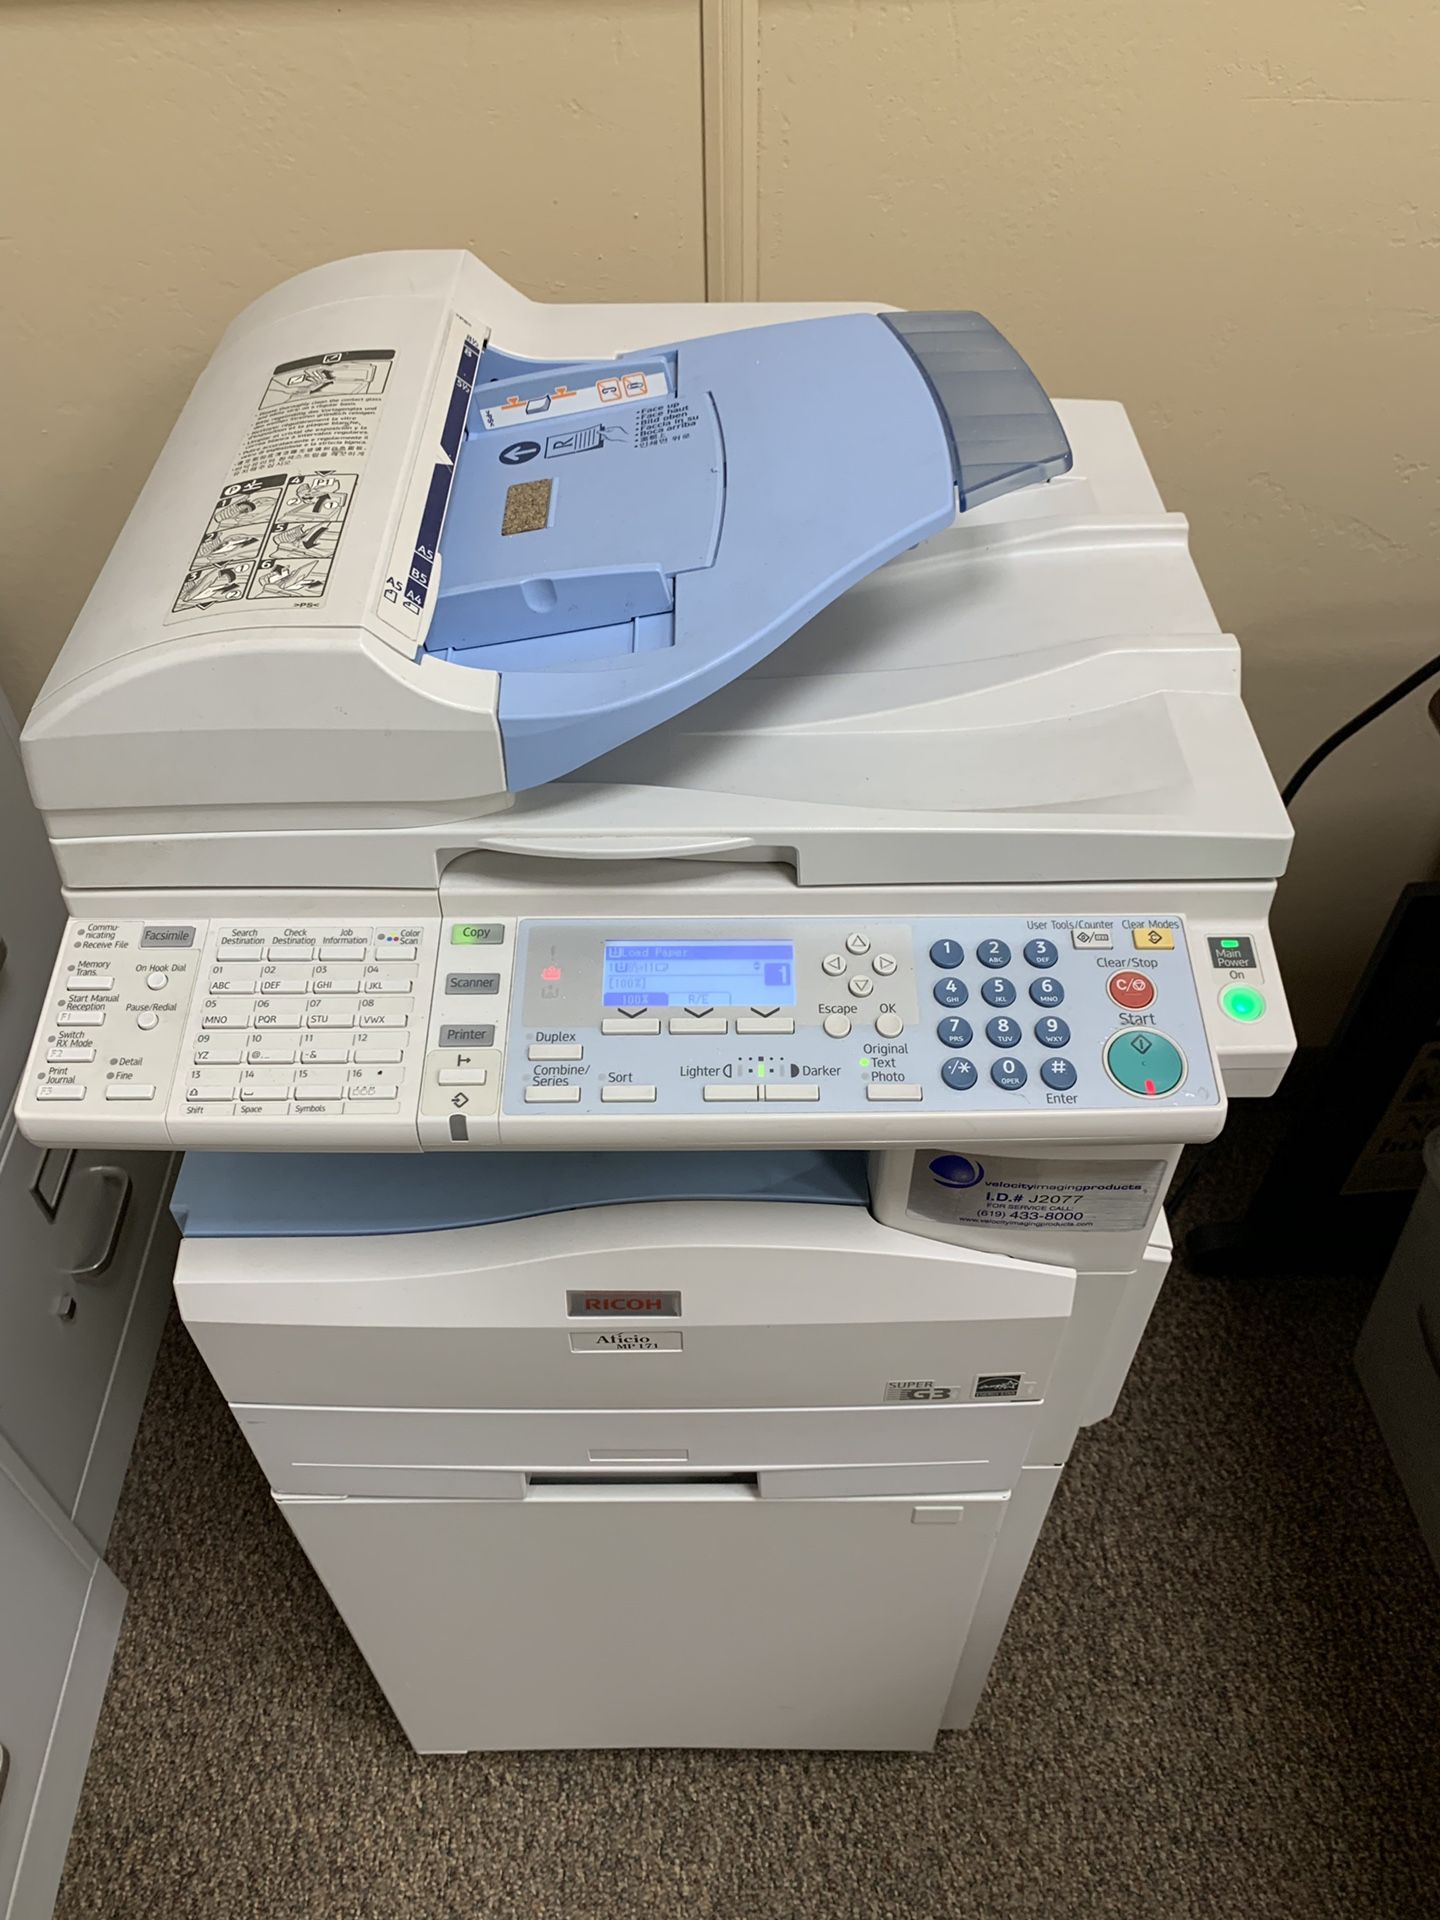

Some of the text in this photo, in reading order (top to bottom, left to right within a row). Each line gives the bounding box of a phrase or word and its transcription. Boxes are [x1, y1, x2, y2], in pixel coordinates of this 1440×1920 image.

[417, 545, 433, 560] A5
[411, 567, 428, 584] B5
[386, 576, 403, 592] A5
[406, 590, 422, 605] A4
[1027, 920, 1114, 930] User Tools/Counter
[1122, 920, 1180, 930] Clear Modes
[85, 931, 116, 940] nicating
[144, 930, 190, 941] Facsimile
[231, 929, 258, 937] Search
[284, 929, 307, 937] Check
[340, 929, 353, 937] Job
[400, 929, 420, 937] Color
[462, 926, 491, 938] Copy
[82, 940, 129, 949] Receive File
[221, 936, 265, 945] Destination
[272, 936, 316, 946] Destination
[323, 936, 368, 945] Information
[400, 936, 419, 945] Scan
[944, 942, 951, 953] 1
[989, 942, 999, 954] 2
[1036, 941, 1046, 954] 3
[1216, 949, 1241, 958] Main
[78, 960, 111, 970] Memory
[135, 963, 187, 972] On Hook Dial
[1096, 957, 1158, 969] Clear/Stop
[1218, 958, 1249, 968] Power
[212, 966, 223, 974] 01
[264, 966, 276, 974] 02
[315, 966, 328, 974] 03
[367, 966, 379, 974] 04
[1229, 970, 1245, 980] On
[212, 982, 231, 990] ABC
[264, 981, 281, 989] DEF
[316, 981, 333, 989] GHI
[368, 982, 383, 990] JKL
[450, 977, 494, 988] Scanner
[945, 980, 957, 992] 4
[994, 980, 1004, 993] 5
[1041, 979, 1053, 993] 6
[68, 994, 119, 1002] Start Manual
[66, 1003, 106, 1012] Reception
[125, 1003, 177, 1012] Pause/Redial
[205, 1000, 217, 1008] 05
[257, 1000, 270, 1008] 06
[309, 1000, 322, 1008] 07
[362, 999, 375, 1008] 08
[818, 1003, 857, 1015] Escape
[879, 1003, 897, 1014] OK
[205, 1016, 228, 1024] MNO
[258, 1016, 277, 1025] PQR
[311, 1015, 329, 1024] STU
[364, 1016, 385, 1024] VWX
[1119, 1013, 1156, 1026] Start
[949, 1019, 960, 1032] 7
[998, 1019, 1009, 1033] 8
[1046, 1019, 1058, 1033] 9
[59, 1031, 85, 1039] Switch
[197, 1034, 210, 1043] 09
[252, 1034, 262, 1043] 10
[305, 1034, 314, 1042] 11
[358, 1033, 368, 1042] 12
[447, 1029, 487, 1040] Printer
[535, 1031, 576, 1043] Duplex
[70, 1039, 93, 1048] Mode
[863, 1043, 909, 1057] Original
[198, 1051, 209, 1060] YZ
[118, 1057, 143, 1066] Detail
[872, 1058, 896, 1068] Text
[49, 1067, 68, 1075] Print
[533, 1064, 590, 1076] Combine/
[802, 1065, 841, 1077] Darker
[1003, 1060, 1015, 1074] 0
[1051, 1060, 1066, 1074] #
[116, 1071, 133, 1080] Fine
[191, 1070, 201, 1079] 13
[245, 1070, 255, 1079] 14
[299, 1070, 309, 1078] 15
[352, 1069, 363, 1078] 16
[680, 1065, 720, 1079] Lighter
[871, 1071, 905, 1082] Photo
[46, 1075, 76, 1084] Journal
[532, 1076, 569, 1087] Series
[608, 1071, 632, 1083] Sort
[1046, 1093, 1078, 1104] Enter
[186, 1107, 204, 1115] Shift
[240, 1105, 263, 1115] Space
[295, 1104, 326, 1114] Symbols
[985, 1181, 1142, 1192] velocityimagingproducts
[985, 1191, 1084, 1205] I.D.# J2077
[976, 1209, 1084, 1221] (619) 433-8000
[585, 1299, 662, 1310] RICOH
[907, 1388, 951, 1400] G3
